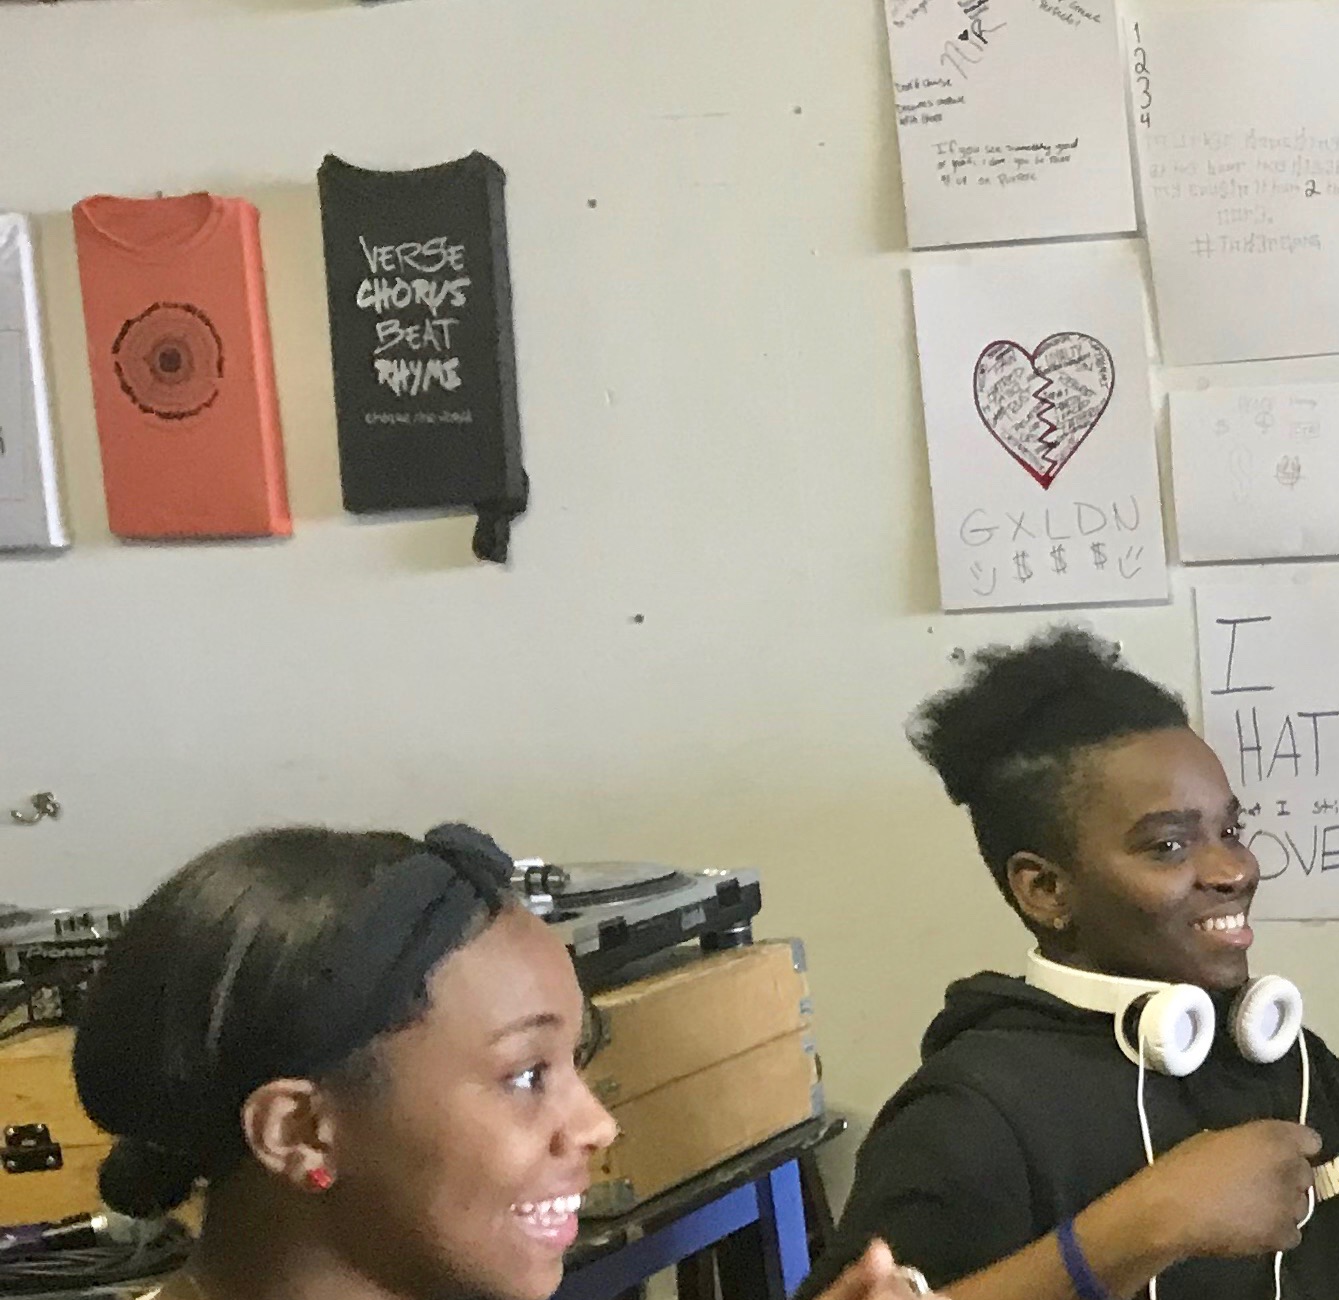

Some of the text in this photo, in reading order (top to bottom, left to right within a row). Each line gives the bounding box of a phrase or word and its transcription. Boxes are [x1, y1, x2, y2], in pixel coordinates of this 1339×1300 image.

[1134, 47, 1149, 74] 2
[358, 234, 465, 275] VERSE
[356, 276, 472, 316] CHORUS
[374, 318, 460, 354] BEAT
[1210, 615, 1275, 696] I
